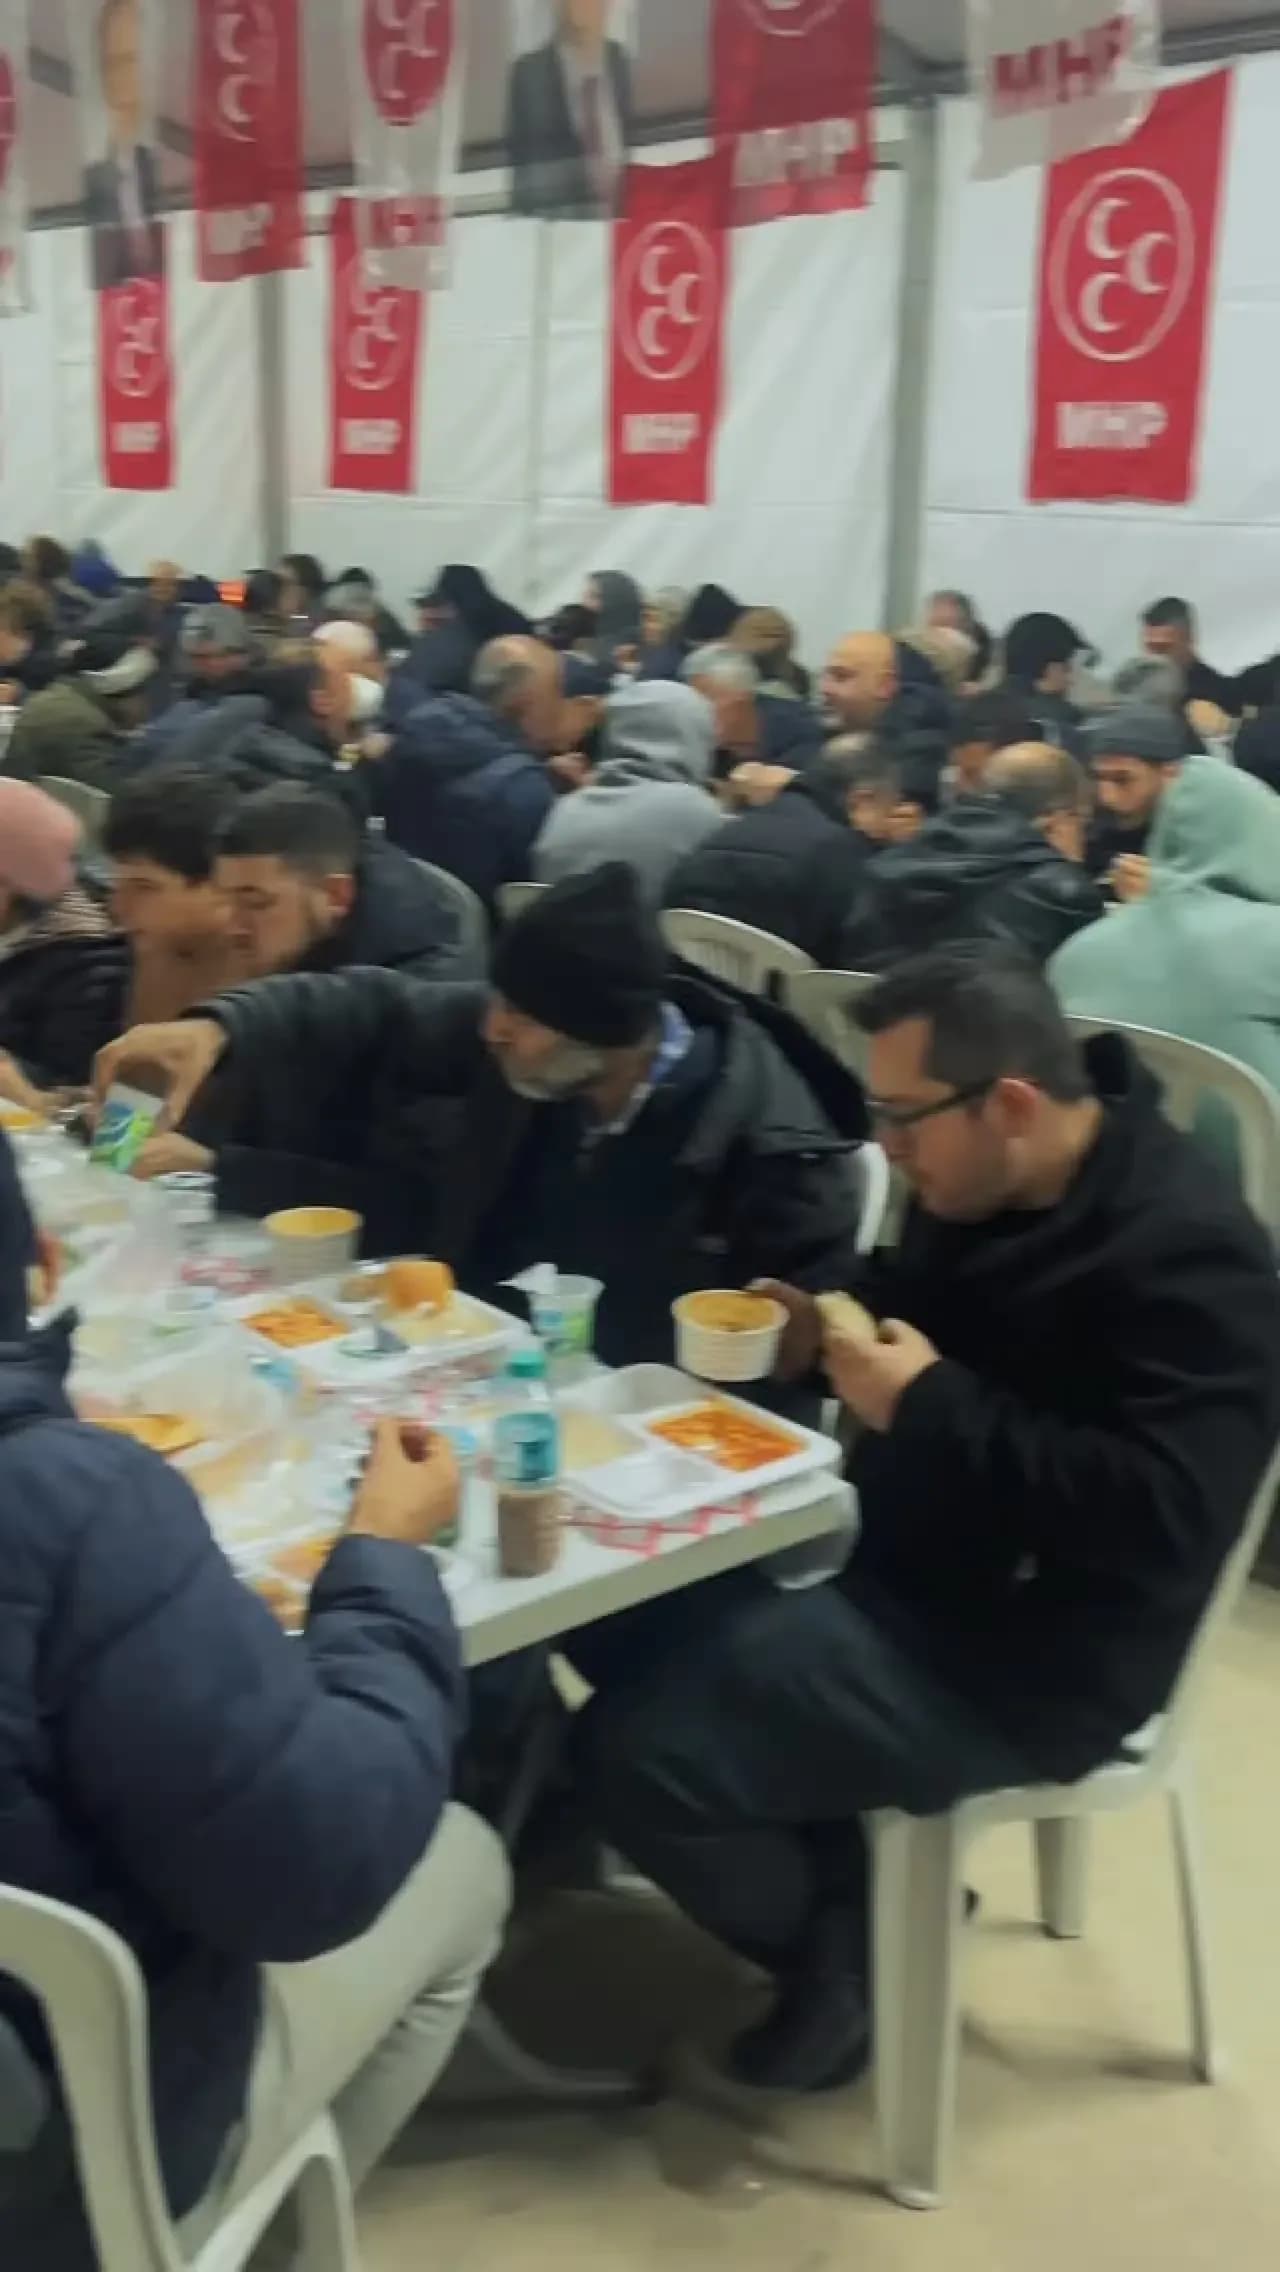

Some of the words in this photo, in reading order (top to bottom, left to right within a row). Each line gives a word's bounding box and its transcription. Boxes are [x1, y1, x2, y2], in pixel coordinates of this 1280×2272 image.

[732, 117, 857, 188] MHP
[622, 413, 699, 454] MHP
[1057, 402, 1168, 449] MHP
